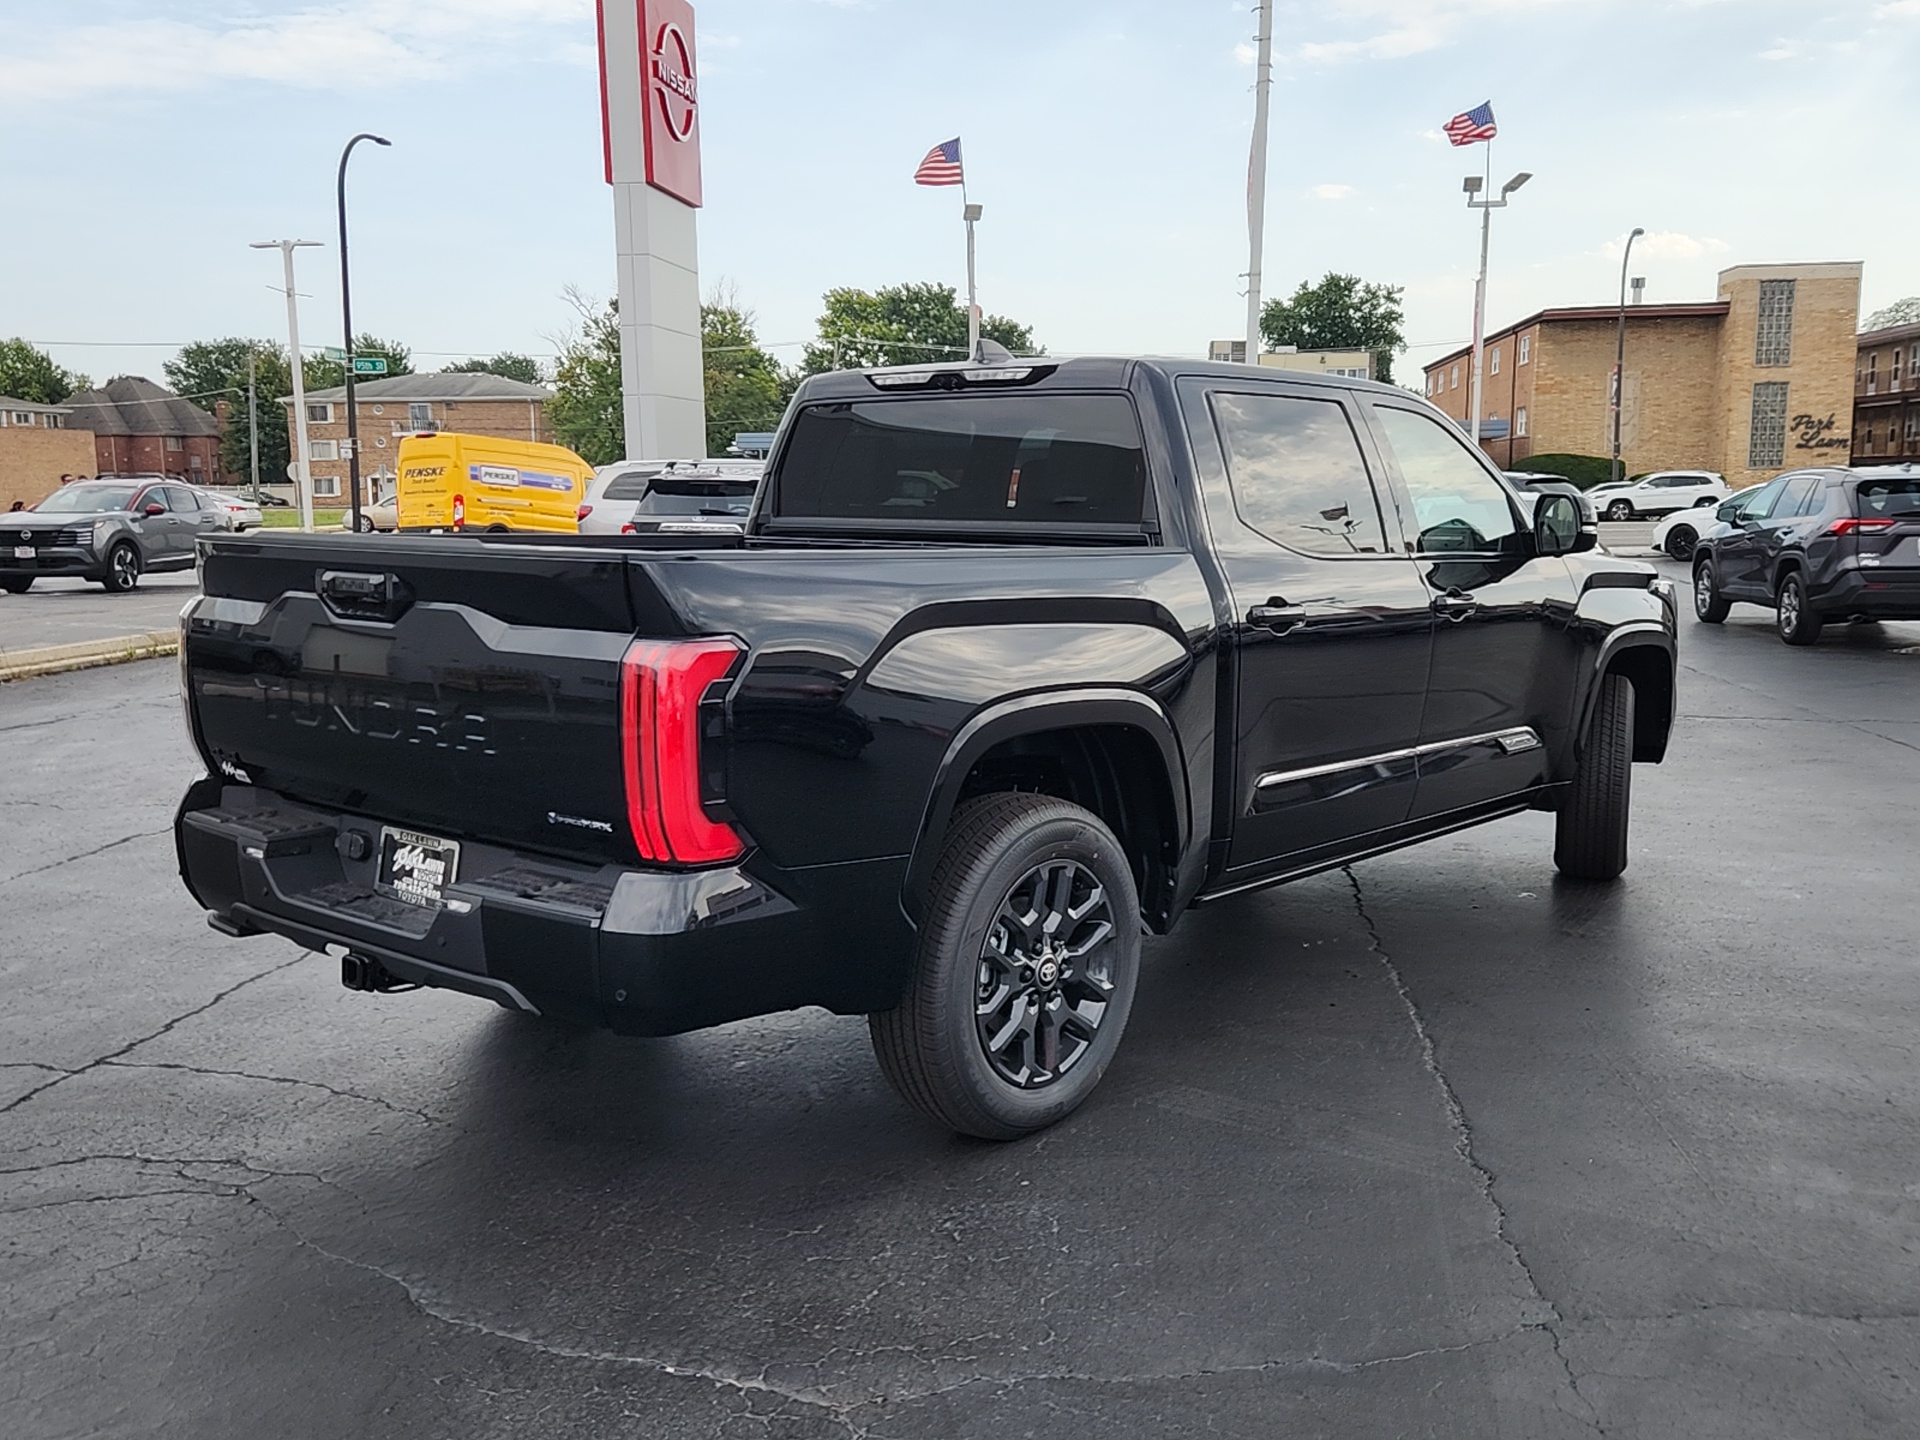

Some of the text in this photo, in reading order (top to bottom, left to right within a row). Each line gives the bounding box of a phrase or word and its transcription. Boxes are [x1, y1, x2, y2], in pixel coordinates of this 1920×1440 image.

[656, 60, 698, 104] NISSAN
[1790, 412, 1836, 432] Park
[1795, 430, 1850, 449] Lawn
[404, 467, 446, 478] PENSKE
[402, 832, 440, 848] OAK LAWN
[398, 890, 426, 906] TOYOTA
